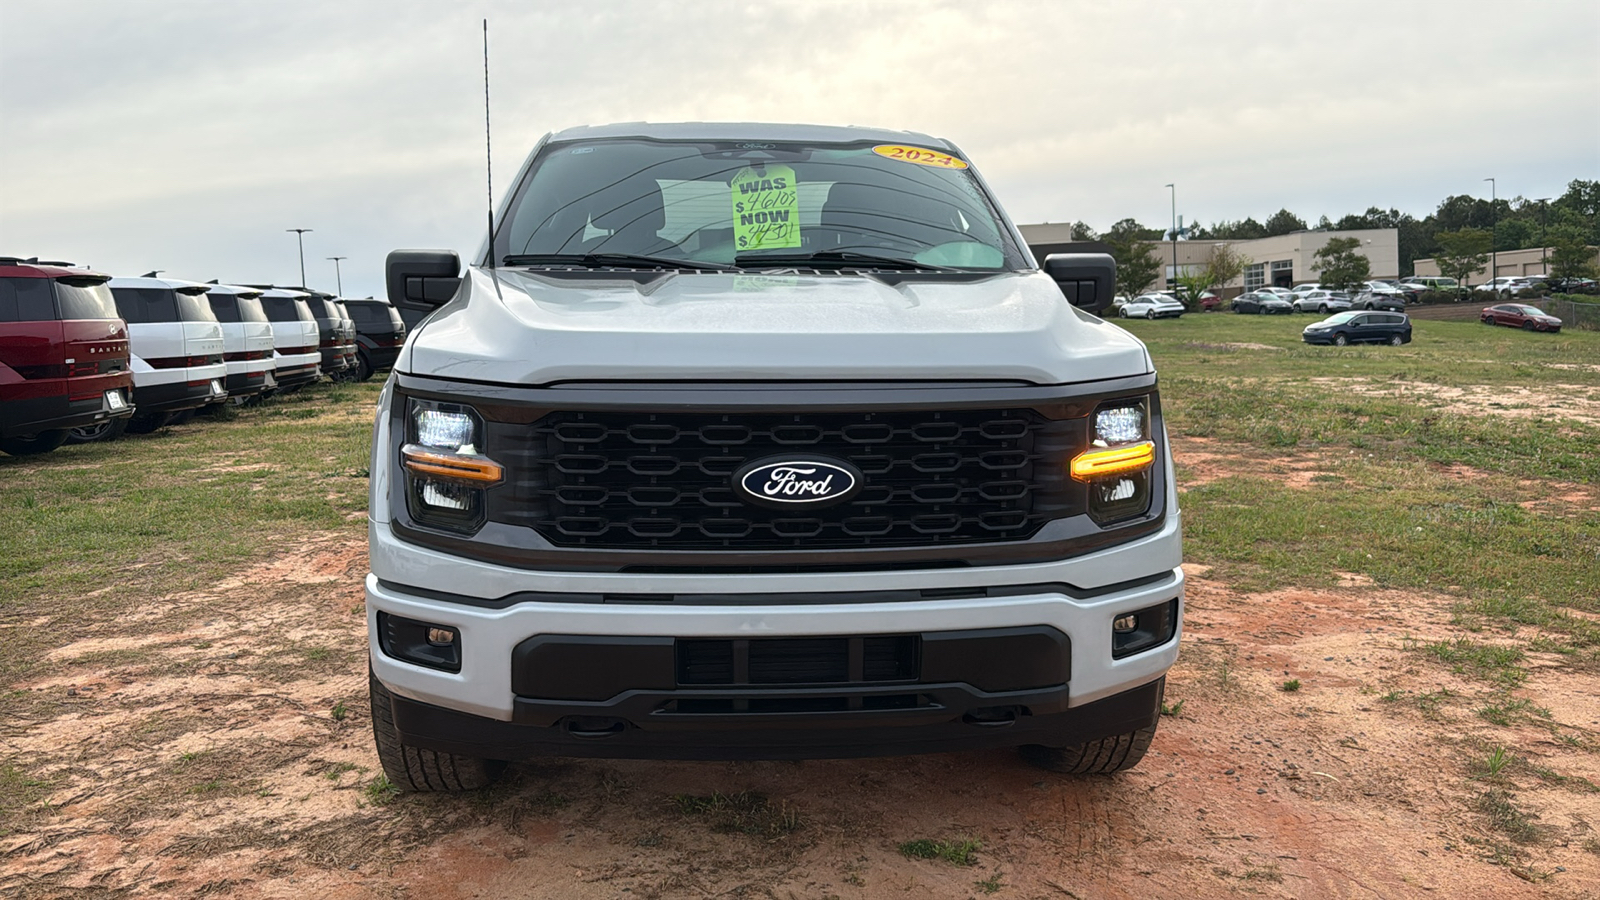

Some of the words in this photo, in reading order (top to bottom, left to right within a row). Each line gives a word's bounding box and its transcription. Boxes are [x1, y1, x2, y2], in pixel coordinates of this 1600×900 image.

[890, 147, 952, 165] 2024
[739, 178, 787, 195] WAS
[740, 209, 790, 226] NOW
[763, 467, 834, 495] Ford
